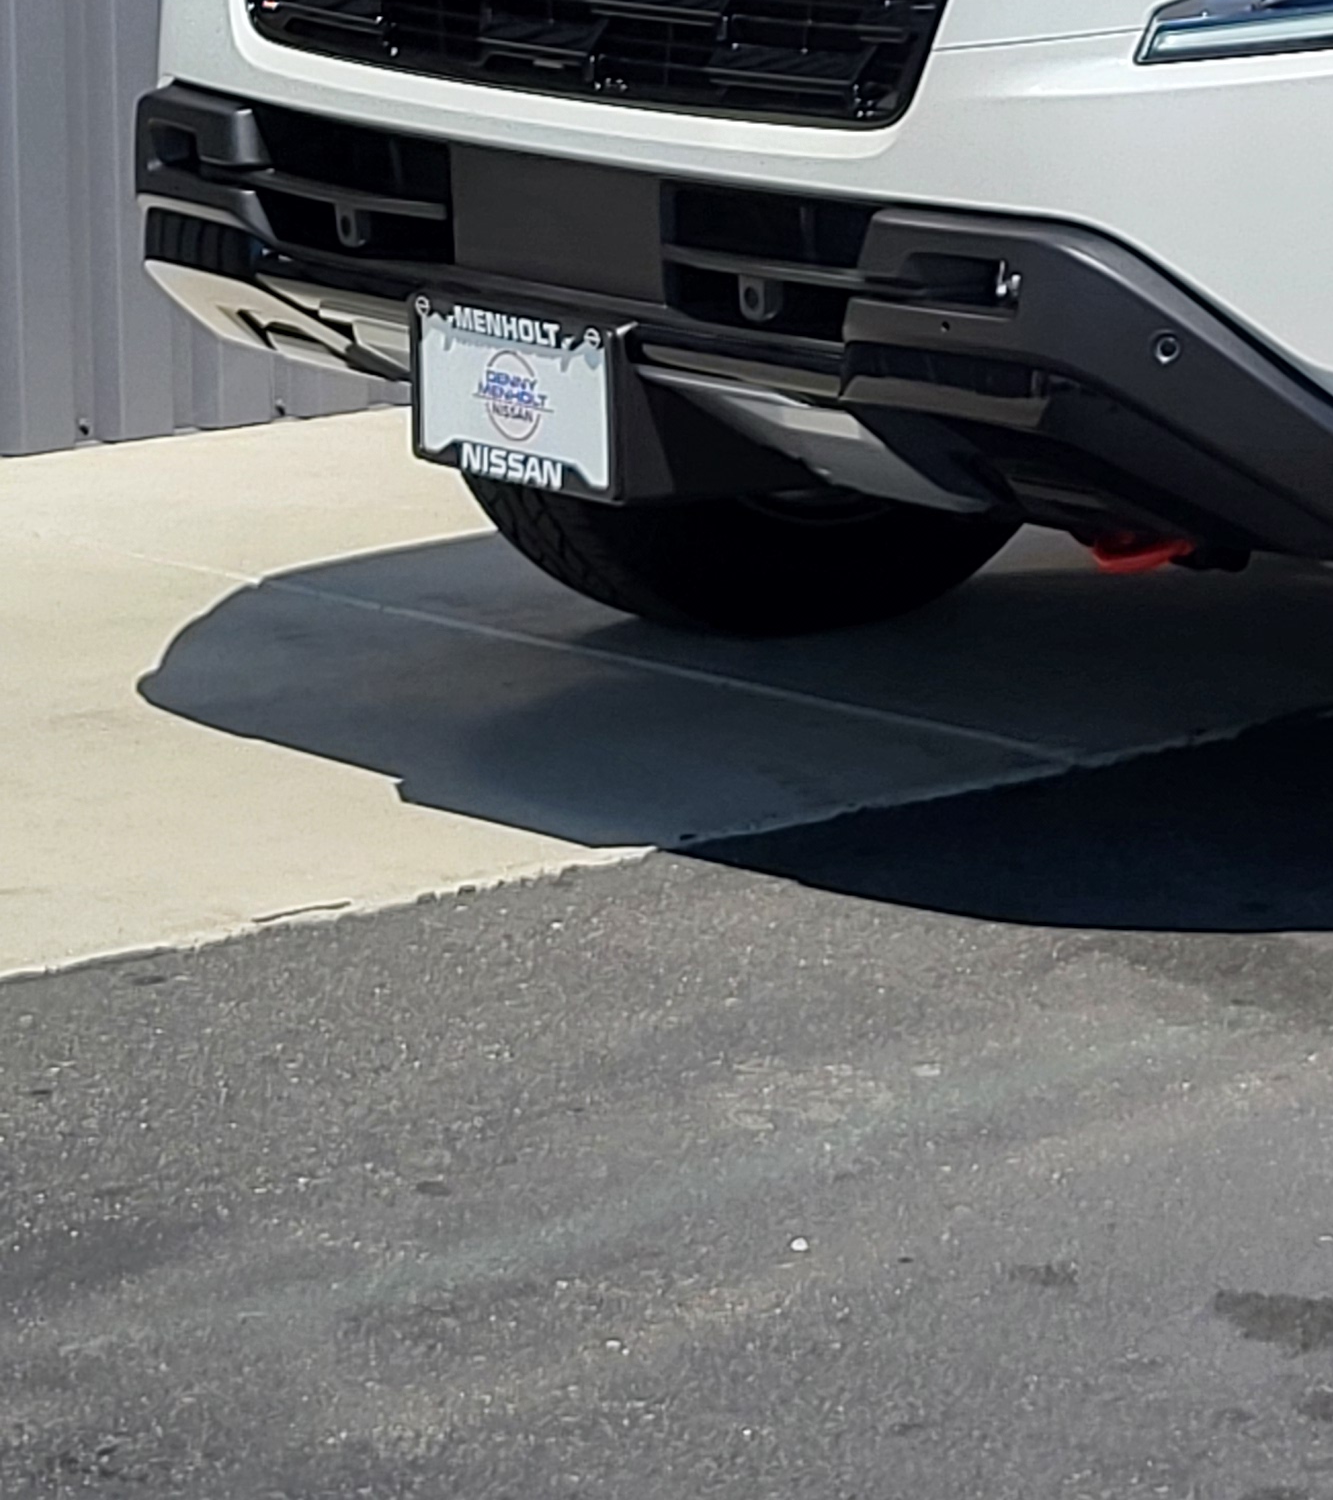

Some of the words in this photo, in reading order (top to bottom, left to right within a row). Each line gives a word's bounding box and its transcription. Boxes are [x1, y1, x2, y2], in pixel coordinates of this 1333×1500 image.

[453, 305, 561, 348] MENHOLT
[478, 380, 548, 407] MENHOLT
[486, 369, 538, 392] DENNY
[491, 402, 534, 423] NISSAN
[460, 442, 563, 491] NISSAN
